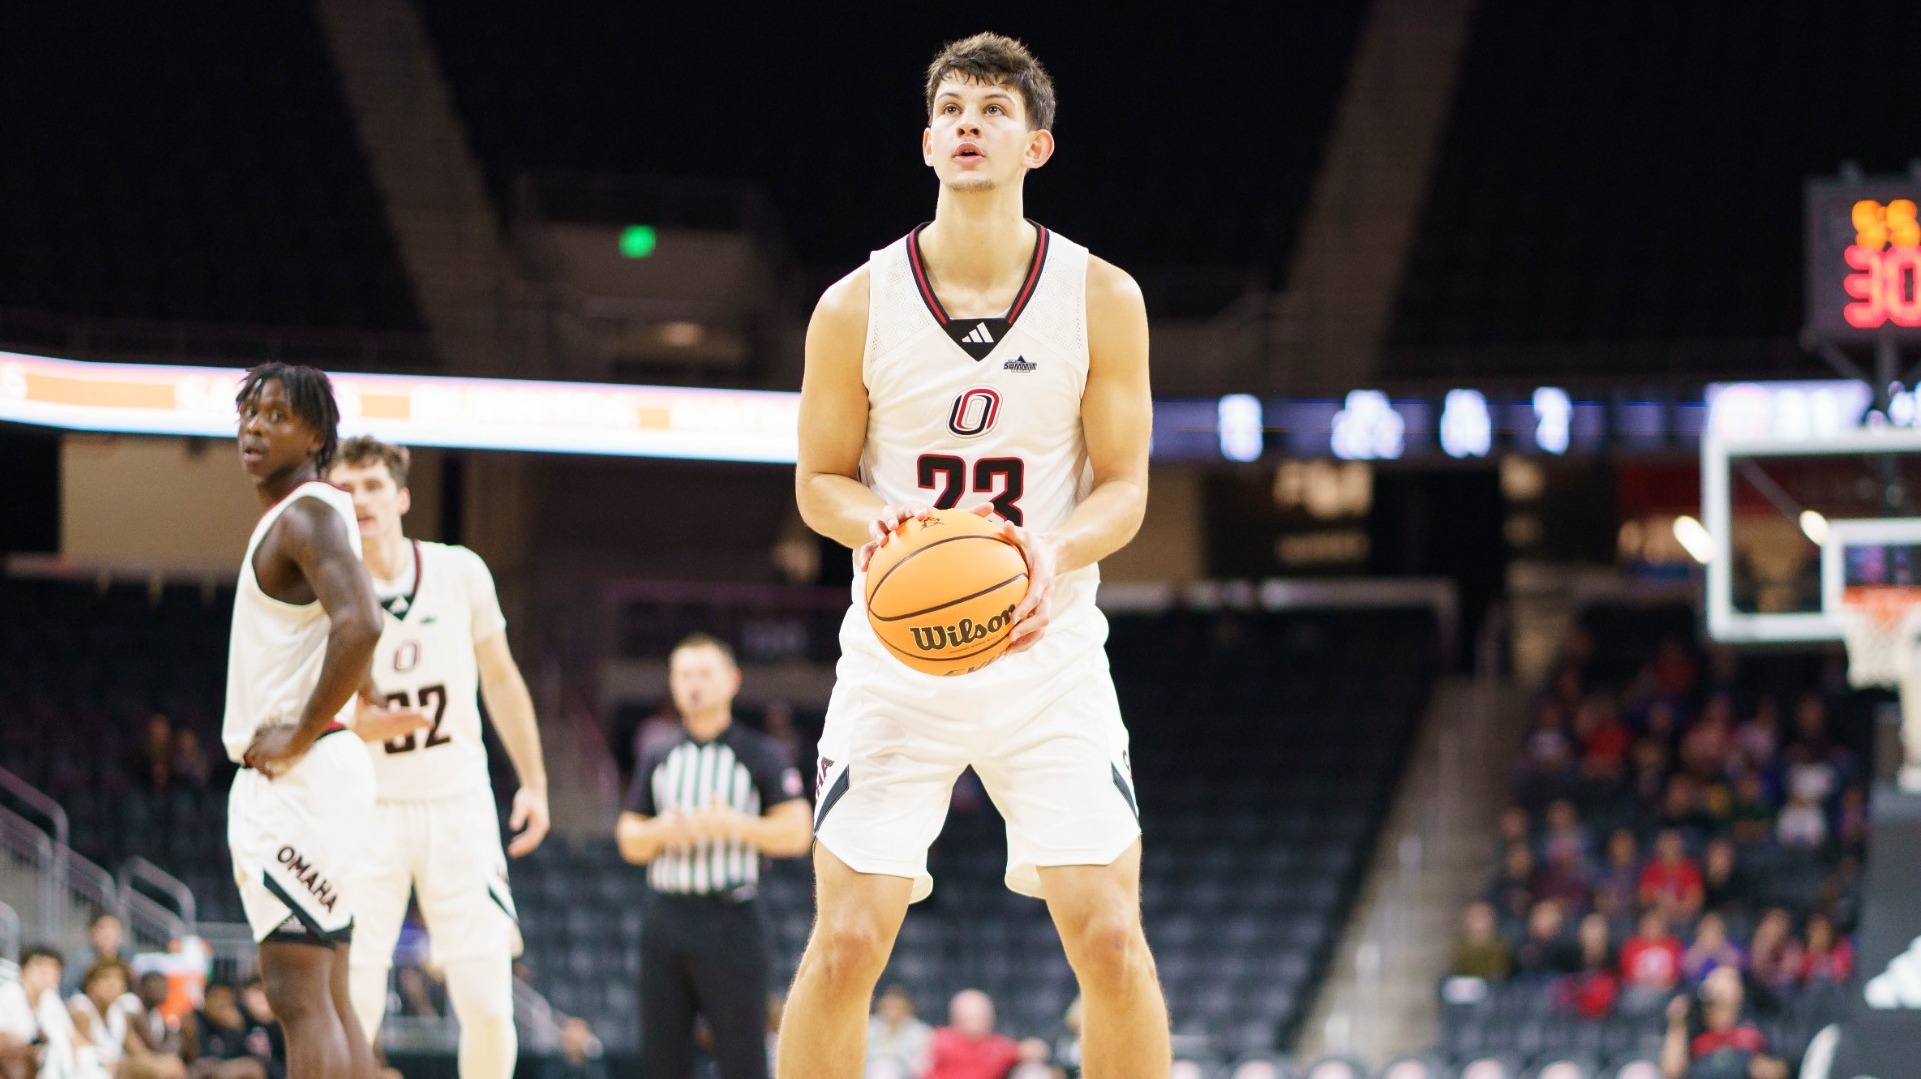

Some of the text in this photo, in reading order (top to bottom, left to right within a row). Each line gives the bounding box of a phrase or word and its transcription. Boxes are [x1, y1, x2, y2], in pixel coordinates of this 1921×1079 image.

[1843, 245, 1921, 328] 30
[917, 453, 1025, 528] 23
[277, 846, 338, 914] OMAHA
